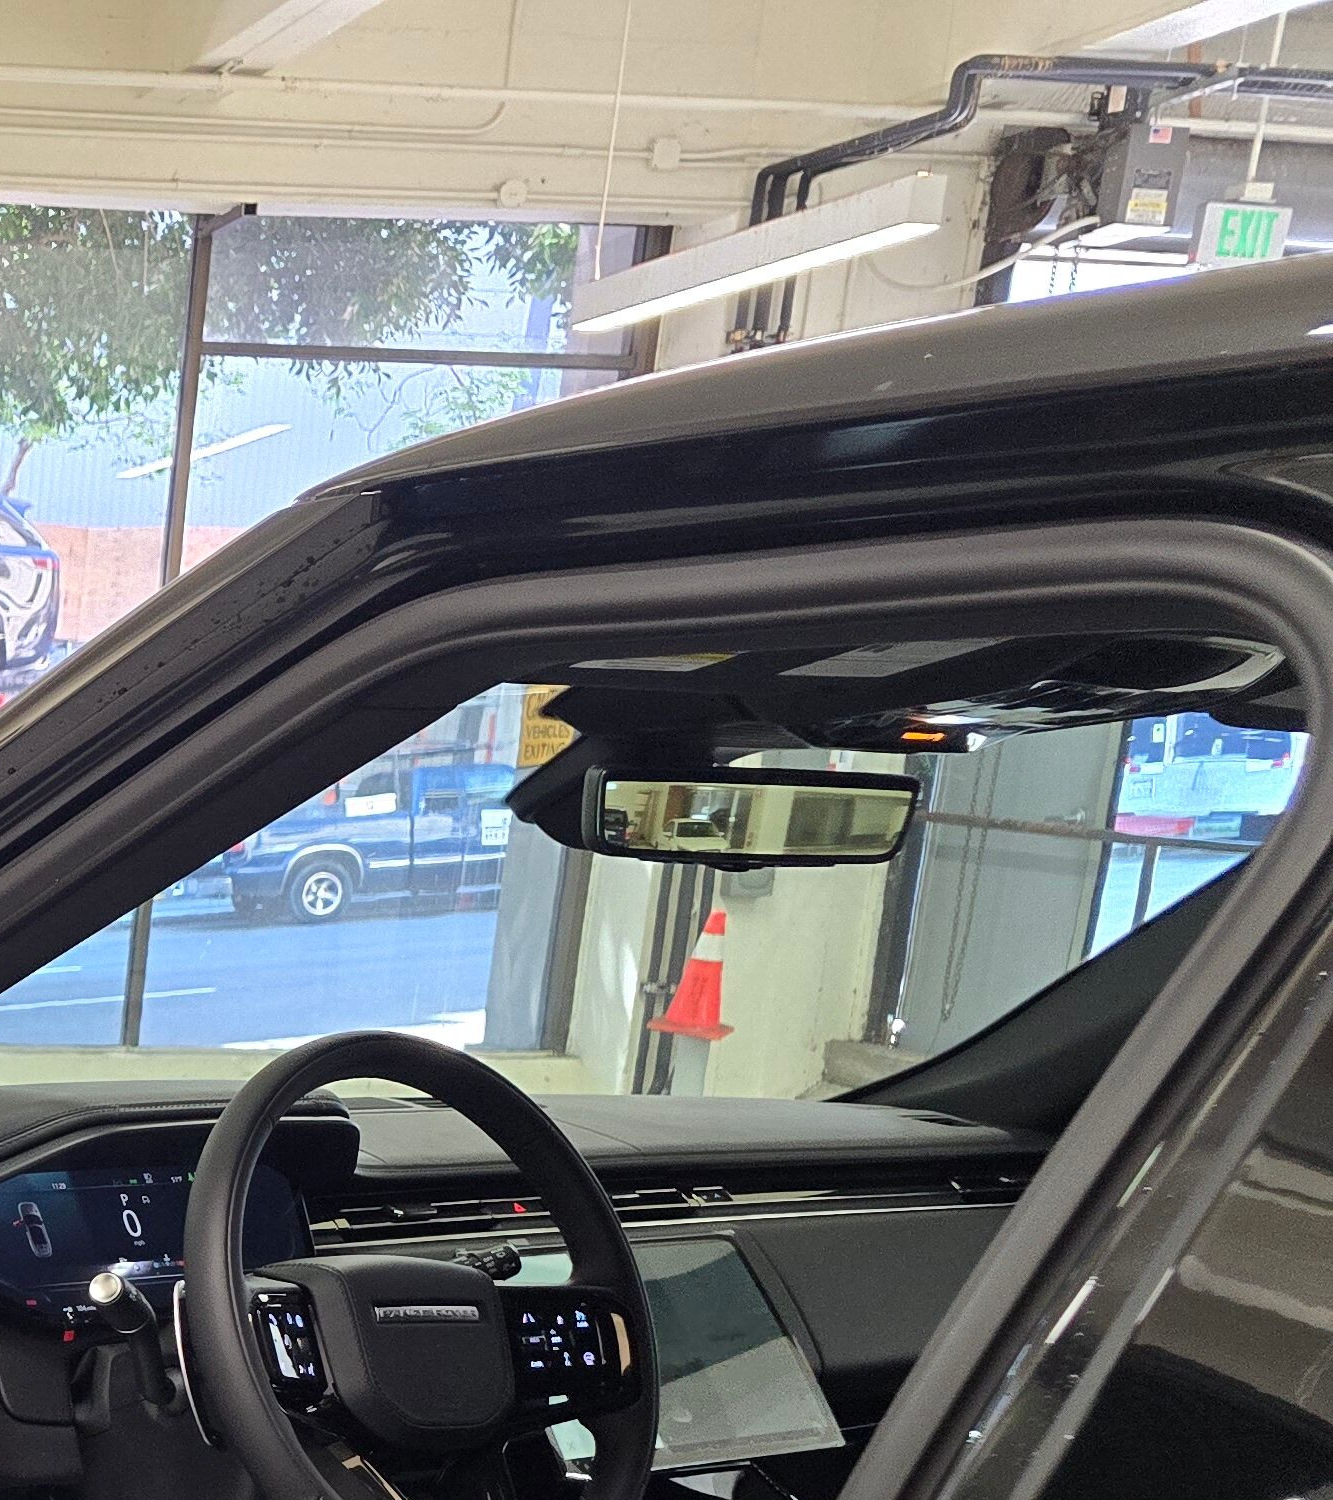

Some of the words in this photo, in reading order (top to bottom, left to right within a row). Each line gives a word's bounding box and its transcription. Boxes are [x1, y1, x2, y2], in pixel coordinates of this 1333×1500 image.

[1216, 208, 1279, 259] EXIT
[526, 724, 570, 740] VEHICLES
[119, 1193, 129, 1206] P
[122, 1209, 142, 1238] 0
